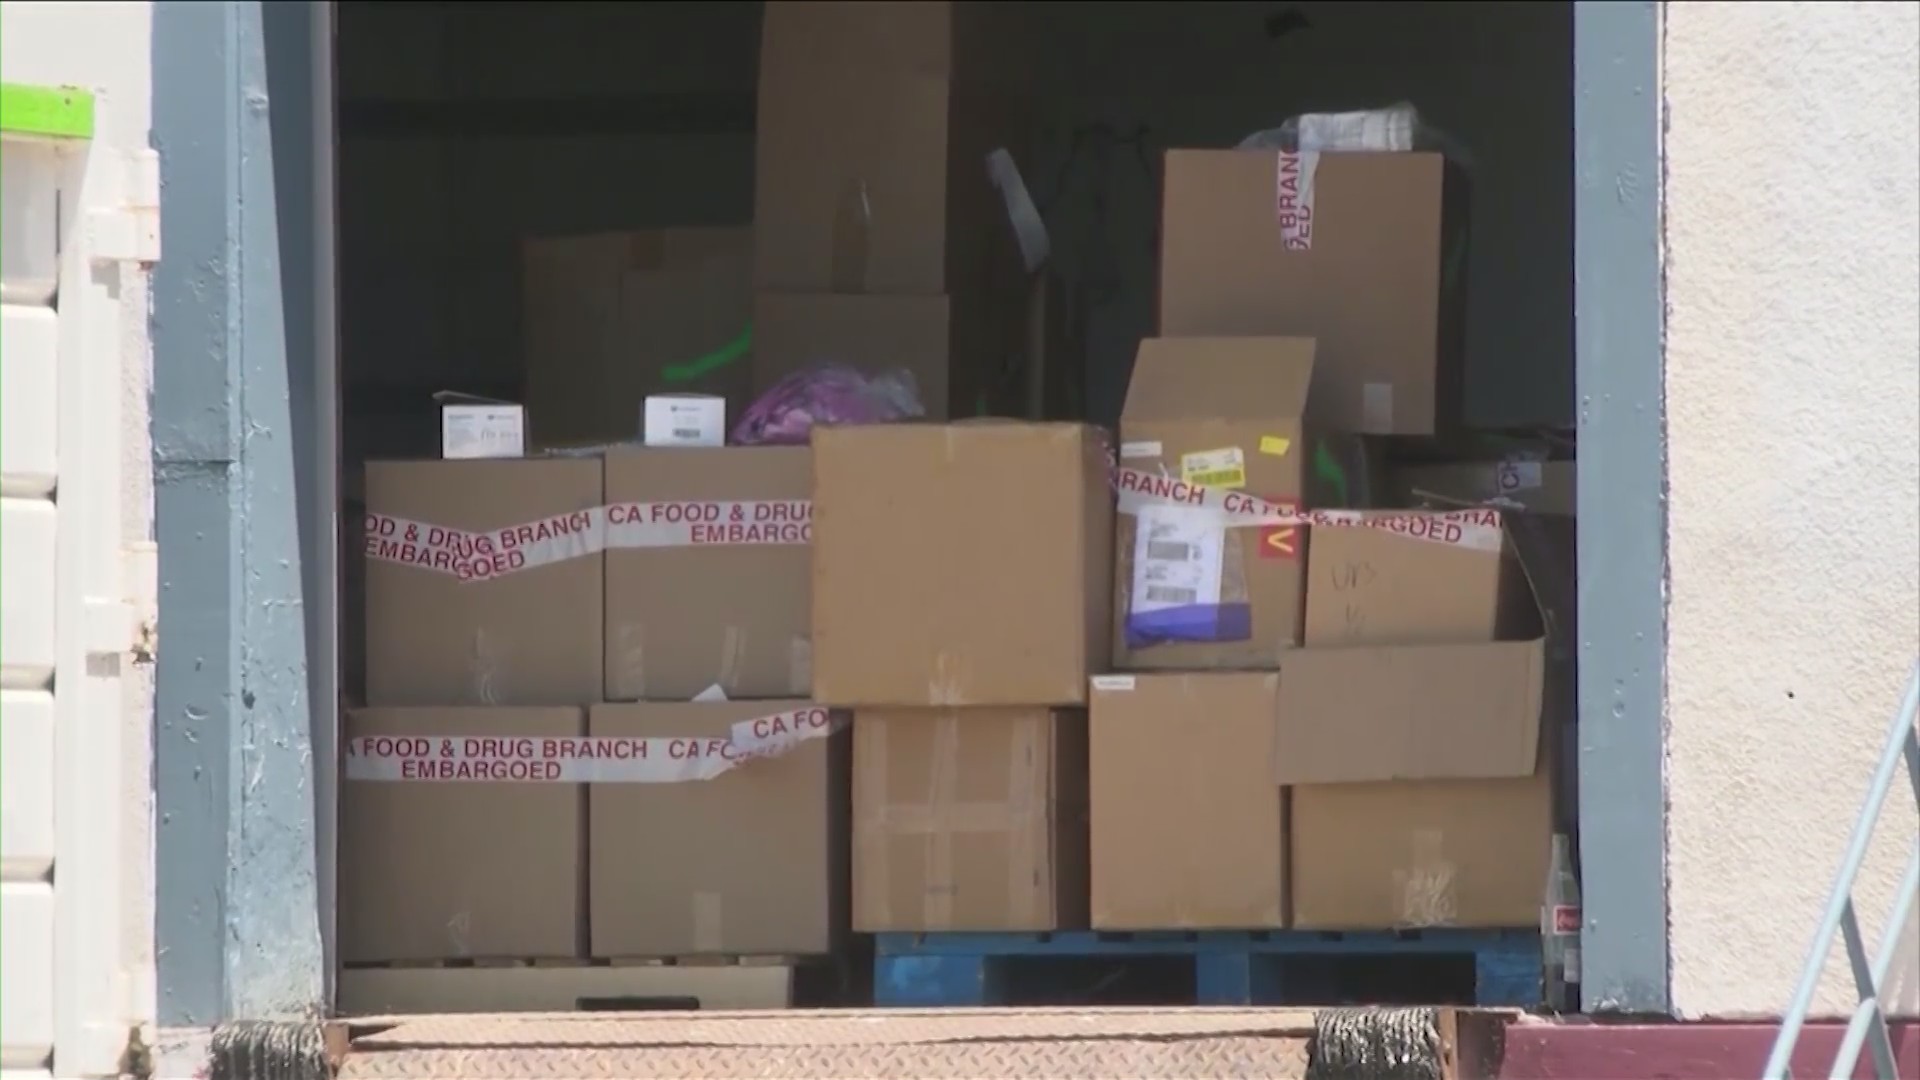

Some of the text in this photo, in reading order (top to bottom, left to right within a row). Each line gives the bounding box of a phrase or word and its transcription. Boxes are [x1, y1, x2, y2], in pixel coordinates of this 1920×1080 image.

[1114, 470, 1205, 505] RANCH
[1223, 493, 1255, 515] CA
[608, 505, 643, 525] CA
[651, 503, 720, 524] FOOD
[729, 504, 745, 522] &
[404, 523, 420, 543] &
[500, 511, 591, 550] BRANCH
[753, 716, 788, 740] CA
[363, 738, 430, 757] FOOD
[440, 739, 455, 757] &
[465, 739, 534, 757] DRUG
[542, 739, 647, 760] BRANCH
[668, 739, 700, 760] CA
[402, 760, 562, 780] EMBARGOED
